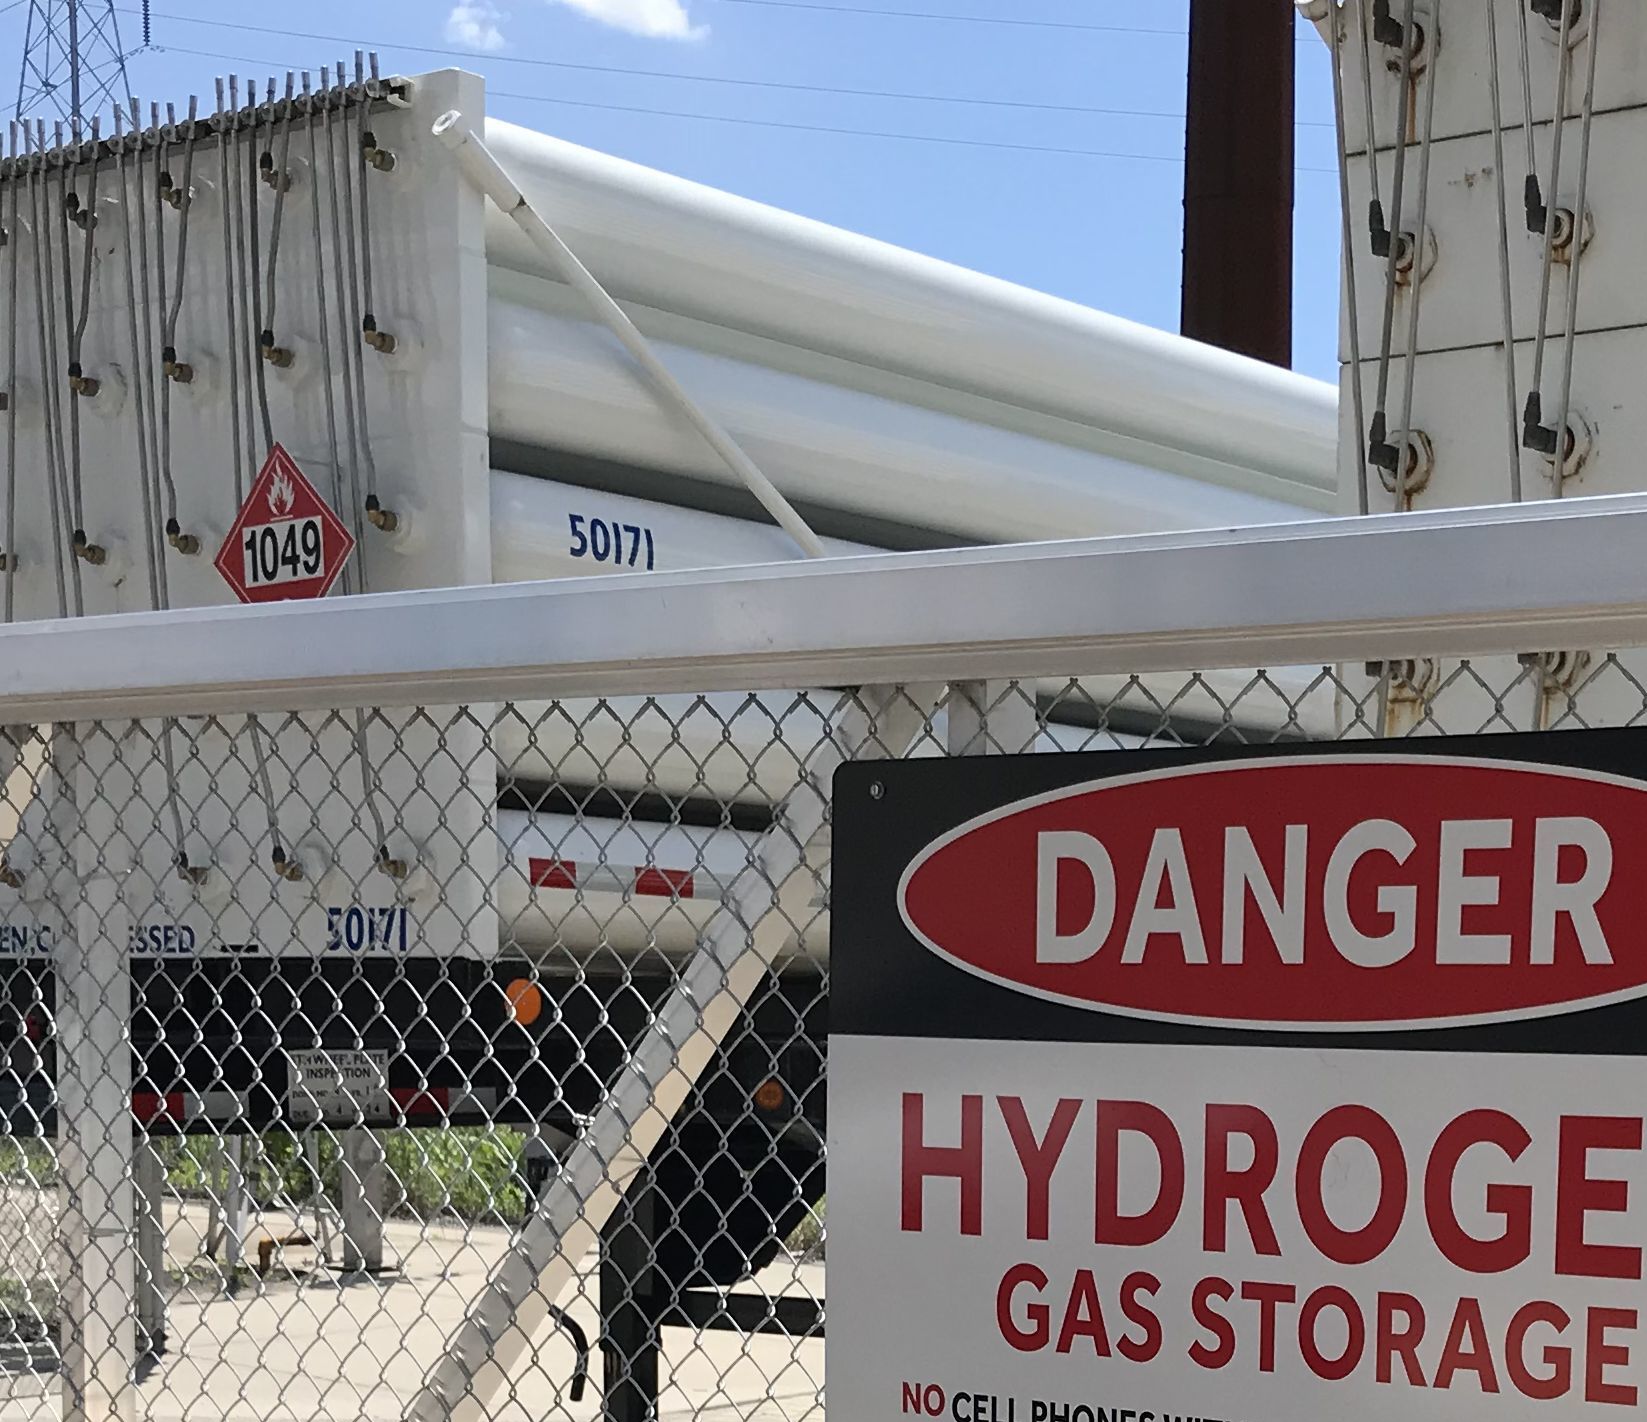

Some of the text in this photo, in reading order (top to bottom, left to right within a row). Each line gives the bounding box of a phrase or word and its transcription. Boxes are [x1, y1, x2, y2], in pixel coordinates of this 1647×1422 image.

[245, 520, 320, 583] 1049
[569, 514, 654, 571] 50171
[1035, 816, 1615, 968] DANGER
[327, 907, 406, 952] 50171
[306, 1067, 371, 1080] INSPETION
[996, 1262, 1638, 1407] GAS STORAGE
[902, 1380, 946, 1417] NO
